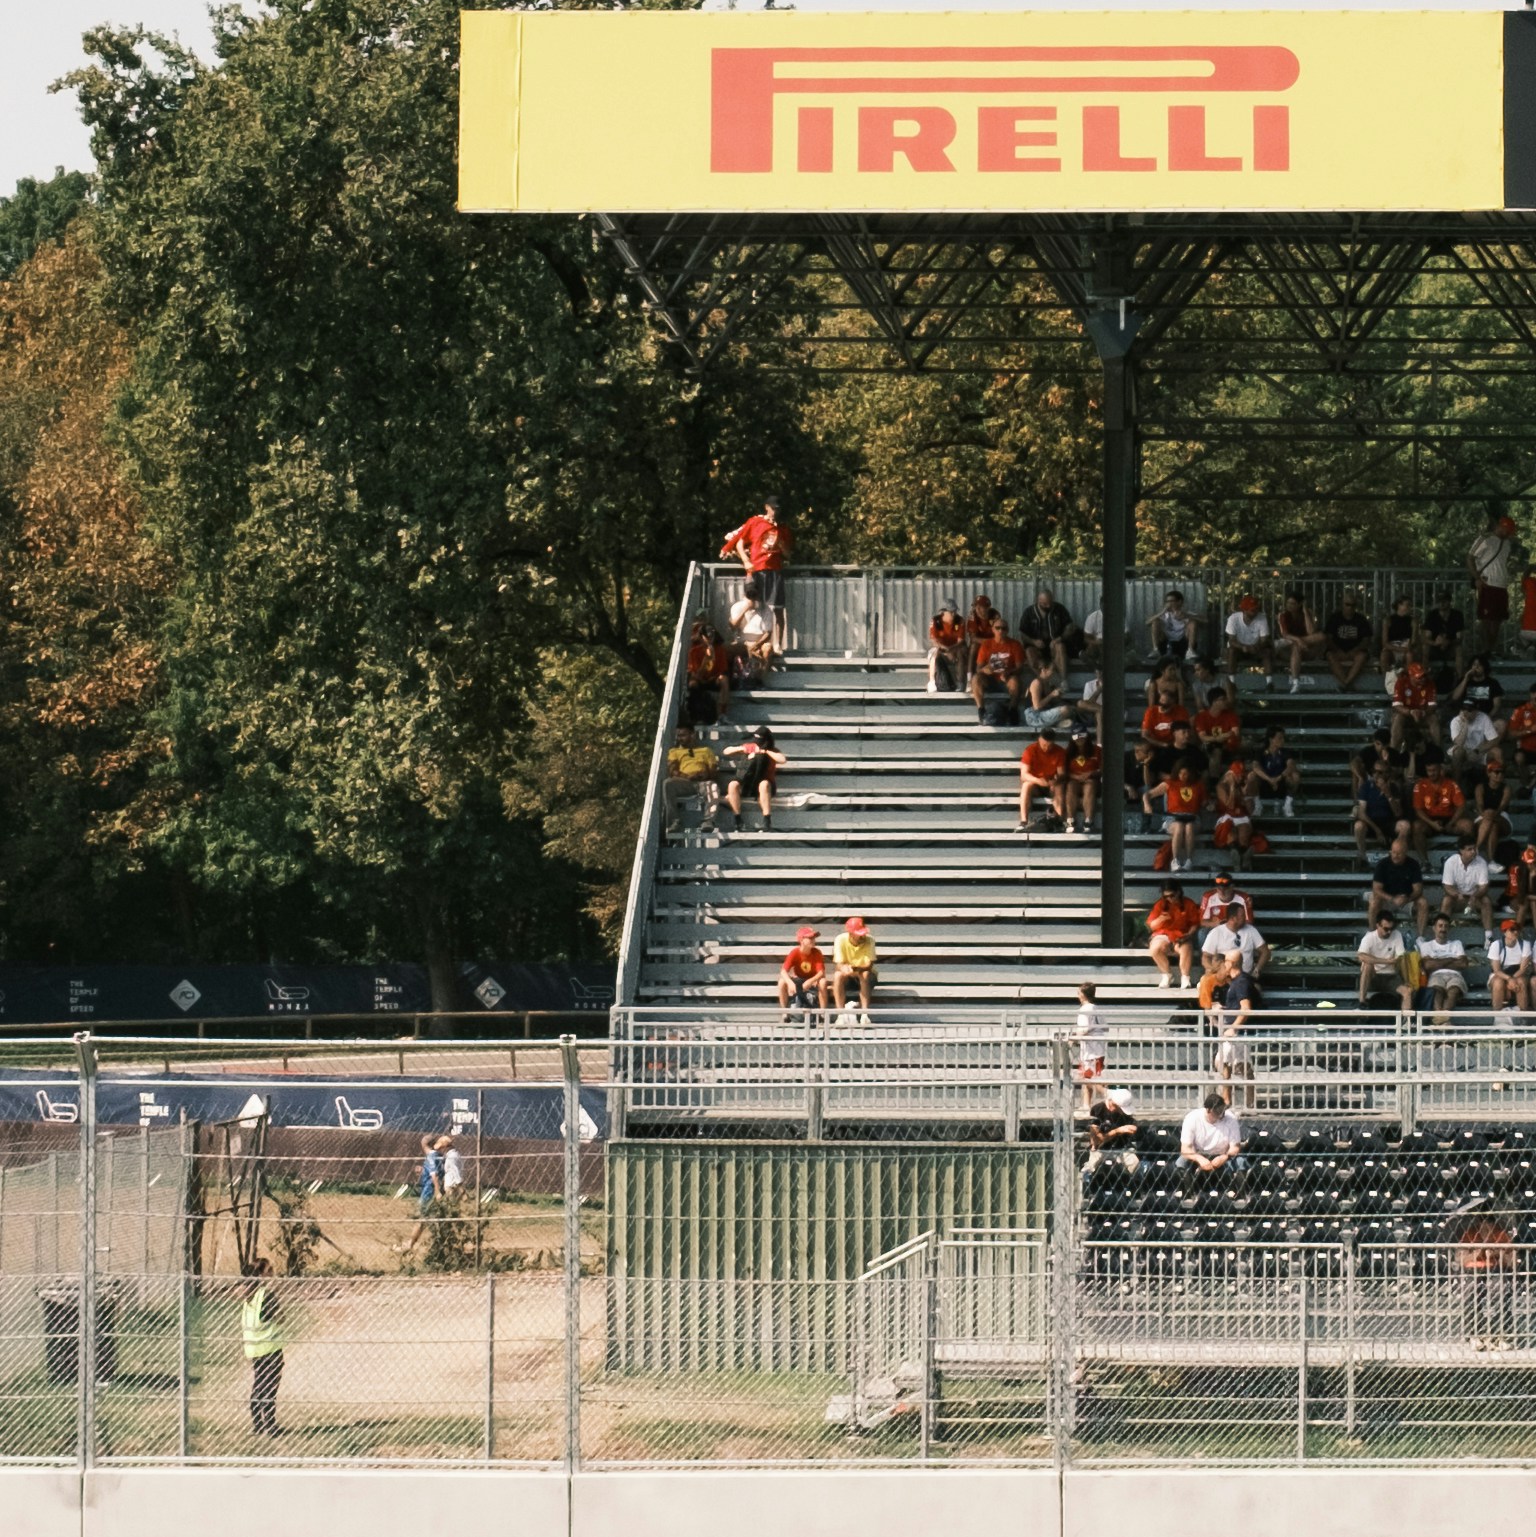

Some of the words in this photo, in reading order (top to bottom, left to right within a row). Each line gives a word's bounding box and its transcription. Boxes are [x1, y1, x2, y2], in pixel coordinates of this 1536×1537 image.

[710, 45, 1300, 173] PIRELLI
[69, 980, 84, 988] THE
[375, 977, 388, 985] THE
[69, 988, 98, 996] TEMPLE
[374, 985, 403, 993] TEMPLE
[69, 996, 79, 1004] OF
[374, 994, 384, 1002] OF
[70, 1005, 94, 1013] SPEED
[269, 1003, 309, 1011] MONZA
[374, 1002, 399, 1010] SPEED
[139, 1092, 155, 1104] THE
[453, 1098, 469, 1111] THE
[140, 1105, 169, 1117] TEMPLE
[452, 1111, 479, 1124] TEMPL
